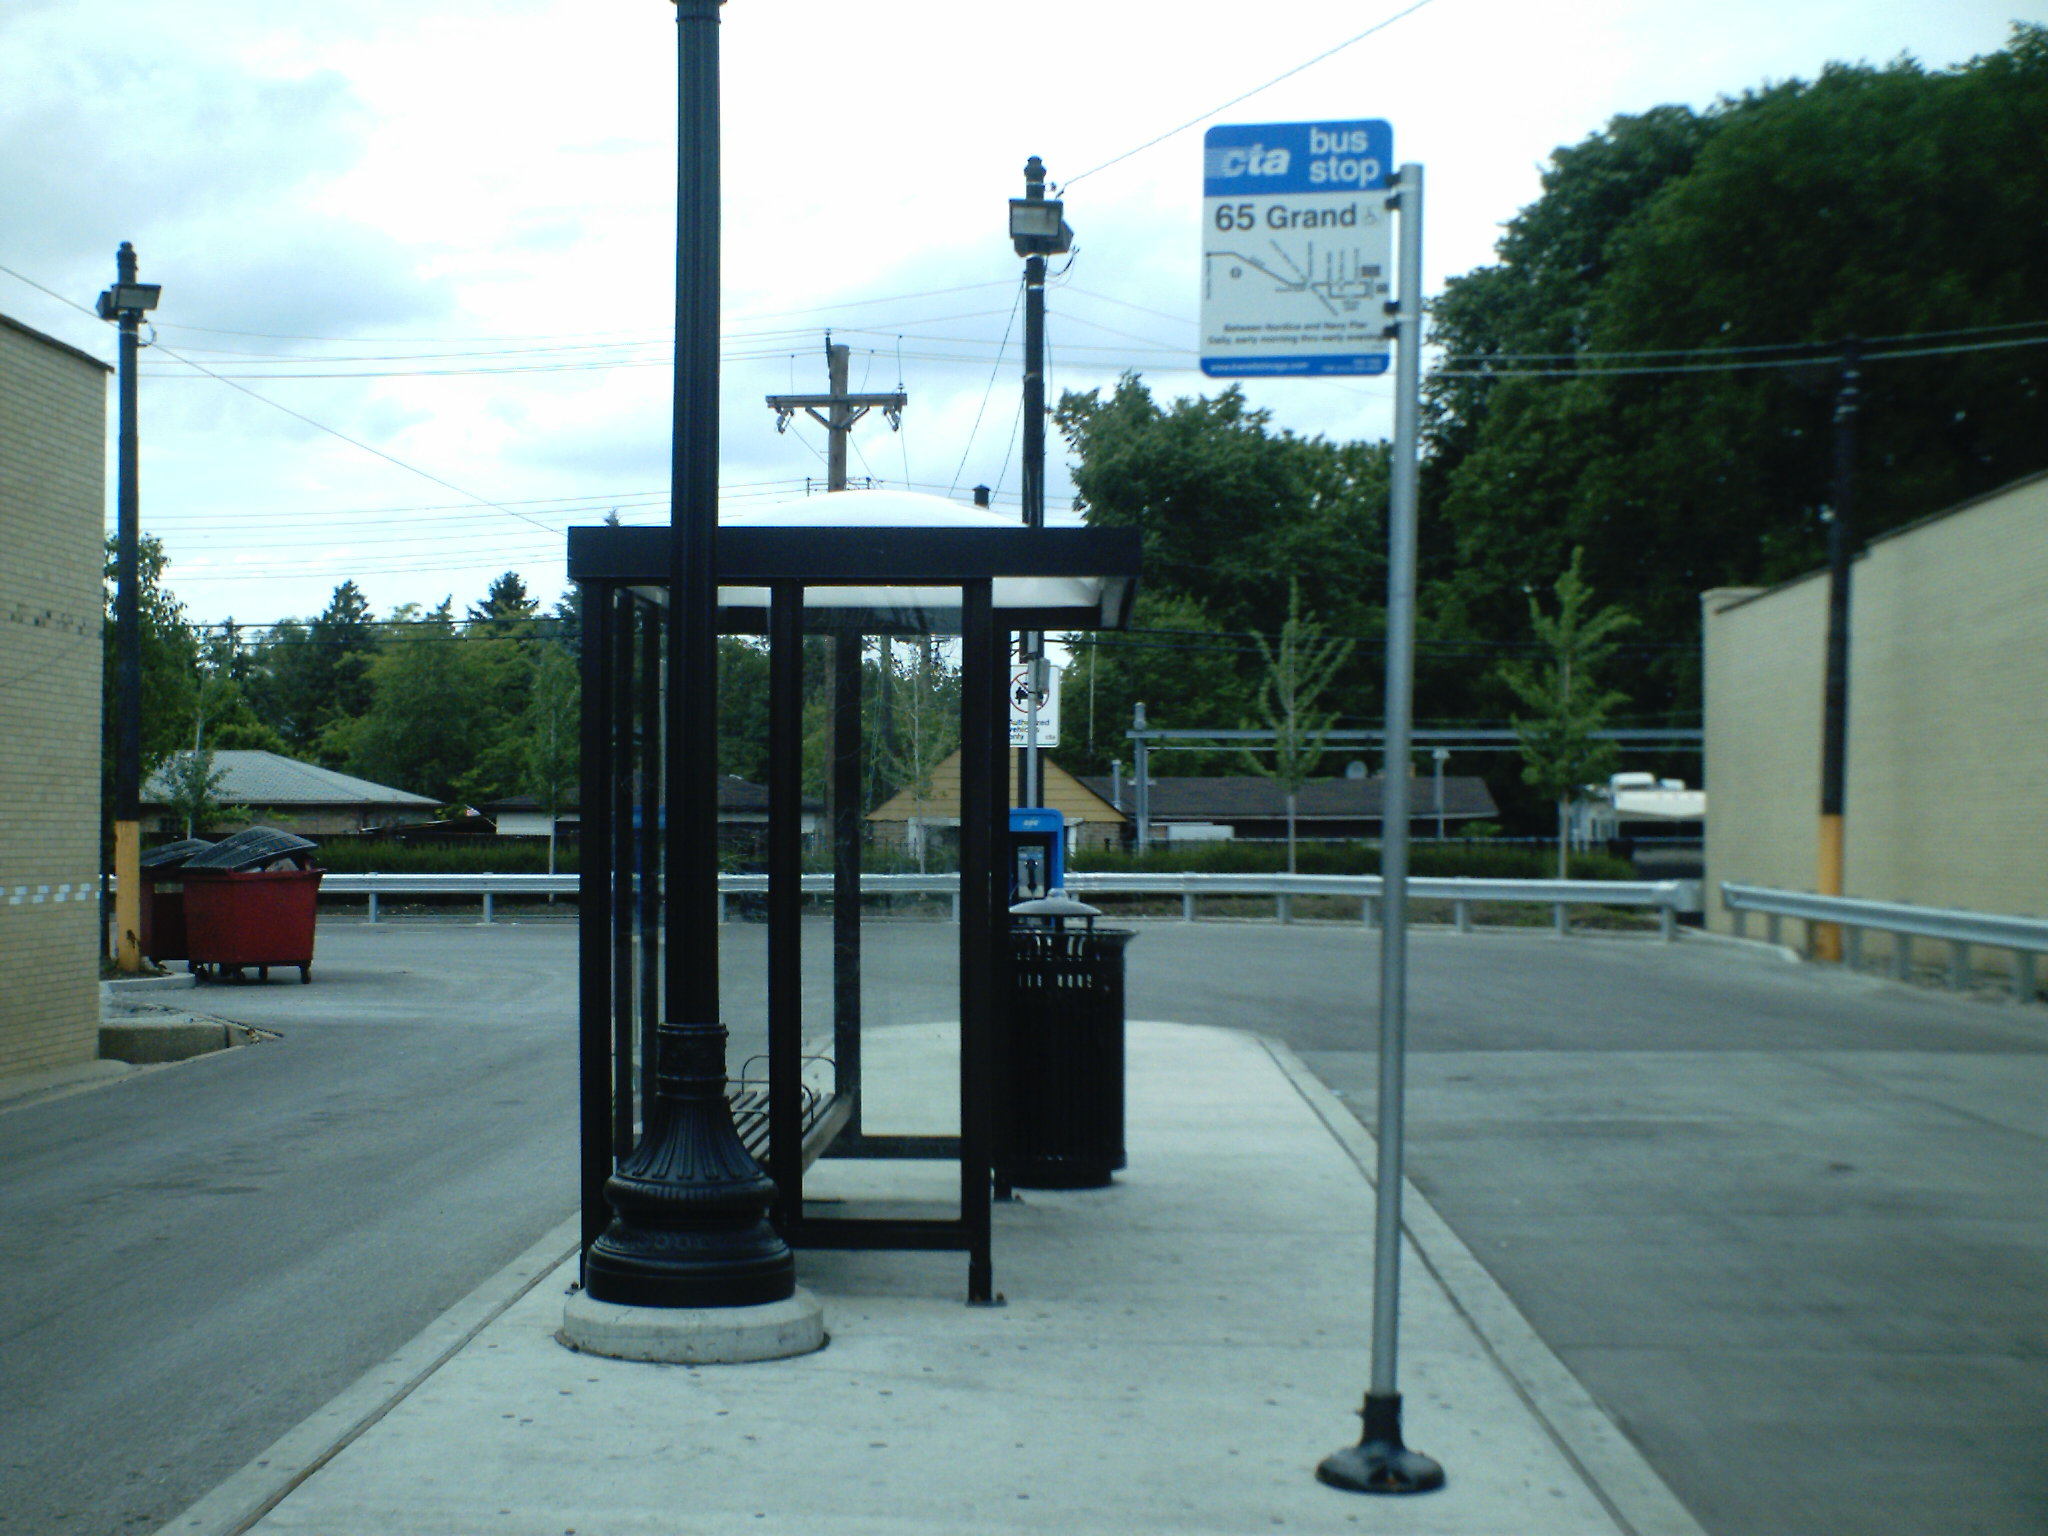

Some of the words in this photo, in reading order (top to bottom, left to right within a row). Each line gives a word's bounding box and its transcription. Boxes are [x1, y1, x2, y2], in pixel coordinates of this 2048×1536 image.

[1310, 126, 1369, 155] bus
[1223, 143, 1291, 177] cta
[1310, 156, 1381, 189] stop
[1215, 203, 1256, 232] 65
[1266, 202, 1357, 230] Grand
